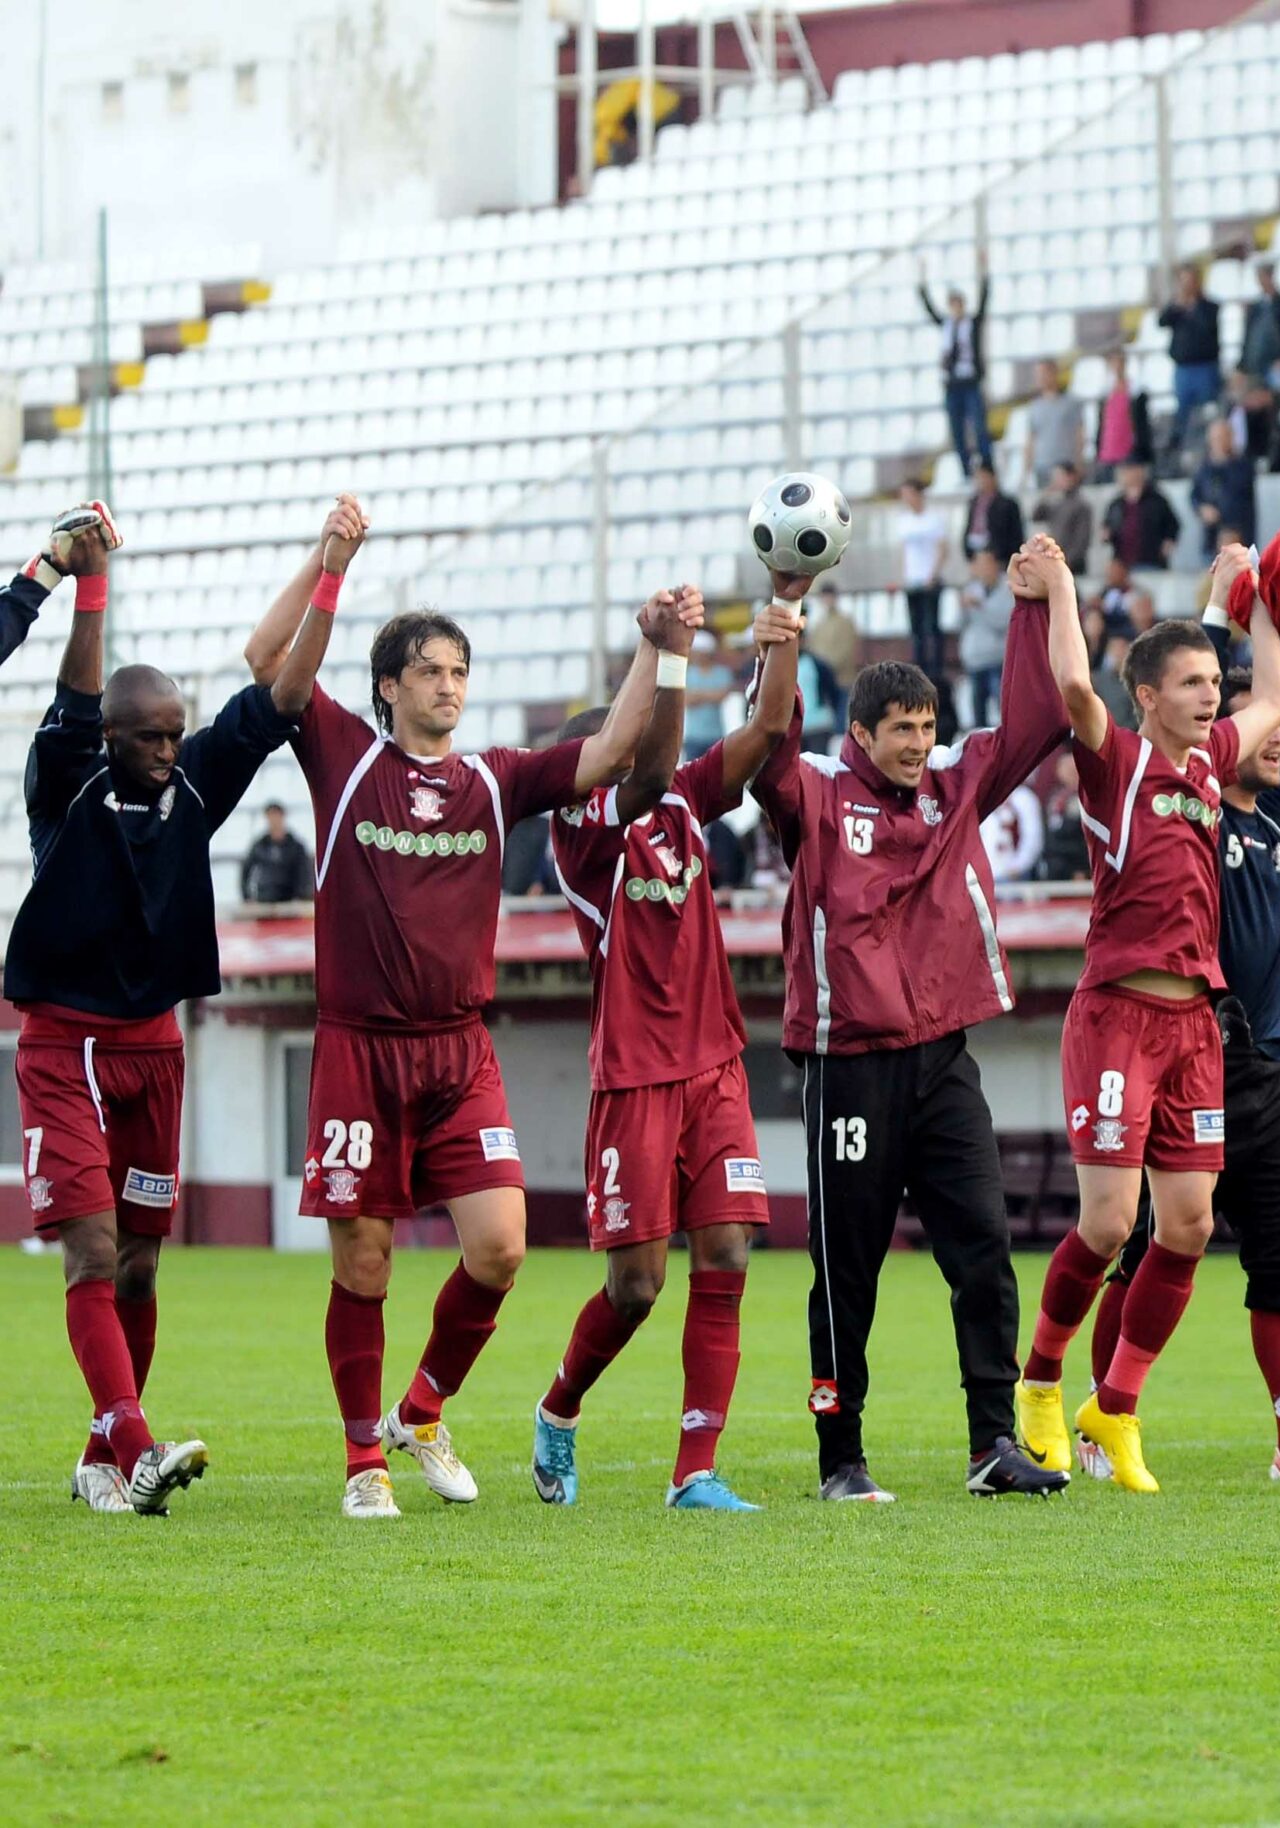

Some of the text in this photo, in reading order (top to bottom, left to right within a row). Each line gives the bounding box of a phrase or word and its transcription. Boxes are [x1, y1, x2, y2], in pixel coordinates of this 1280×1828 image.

[122, 802, 149, 812] lotto
[378, 829, 484, 854] UNIBET
[843, 815, 874, 856] 13
[1226, 833, 1244, 868] 5
[1098, 1070, 1125, 1117] 8
[24, 1127, 43, 1176] 7
[322, 1119, 373, 1169] 28
[831, 1116, 867, 1161] 13
[601, 1147, 621, 1195] 2
